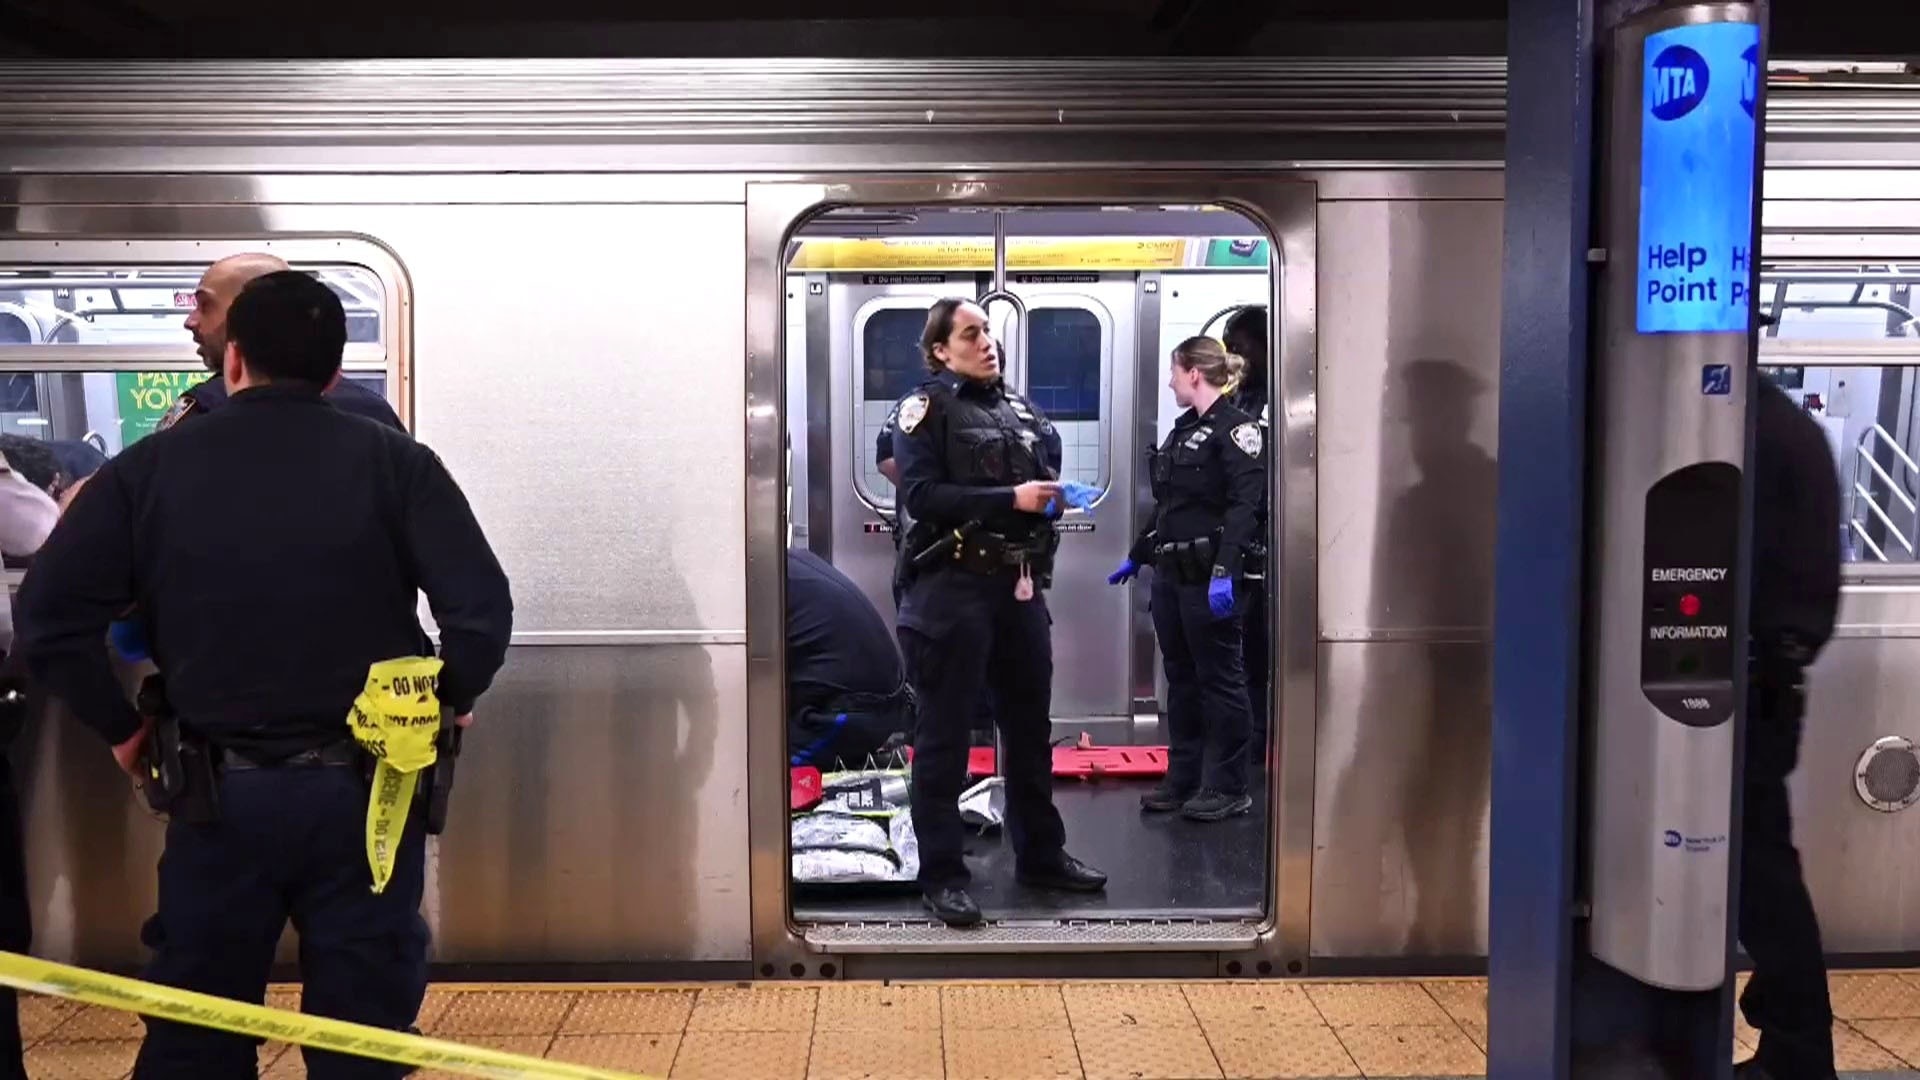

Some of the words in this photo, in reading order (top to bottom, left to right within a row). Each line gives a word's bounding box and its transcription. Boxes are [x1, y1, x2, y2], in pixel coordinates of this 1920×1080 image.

[1652, 66, 1696, 107] MTA
[1648, 243, 1707, 273] Help
[1647, 278, 1717, 304] Point
[138, 372, 179, 386] PAY
[1651, 568, 1728, 581] EMERGENCY
[1650, 626, 1728, 640] INFORMATION
[393, 676, 410, 696] DO
